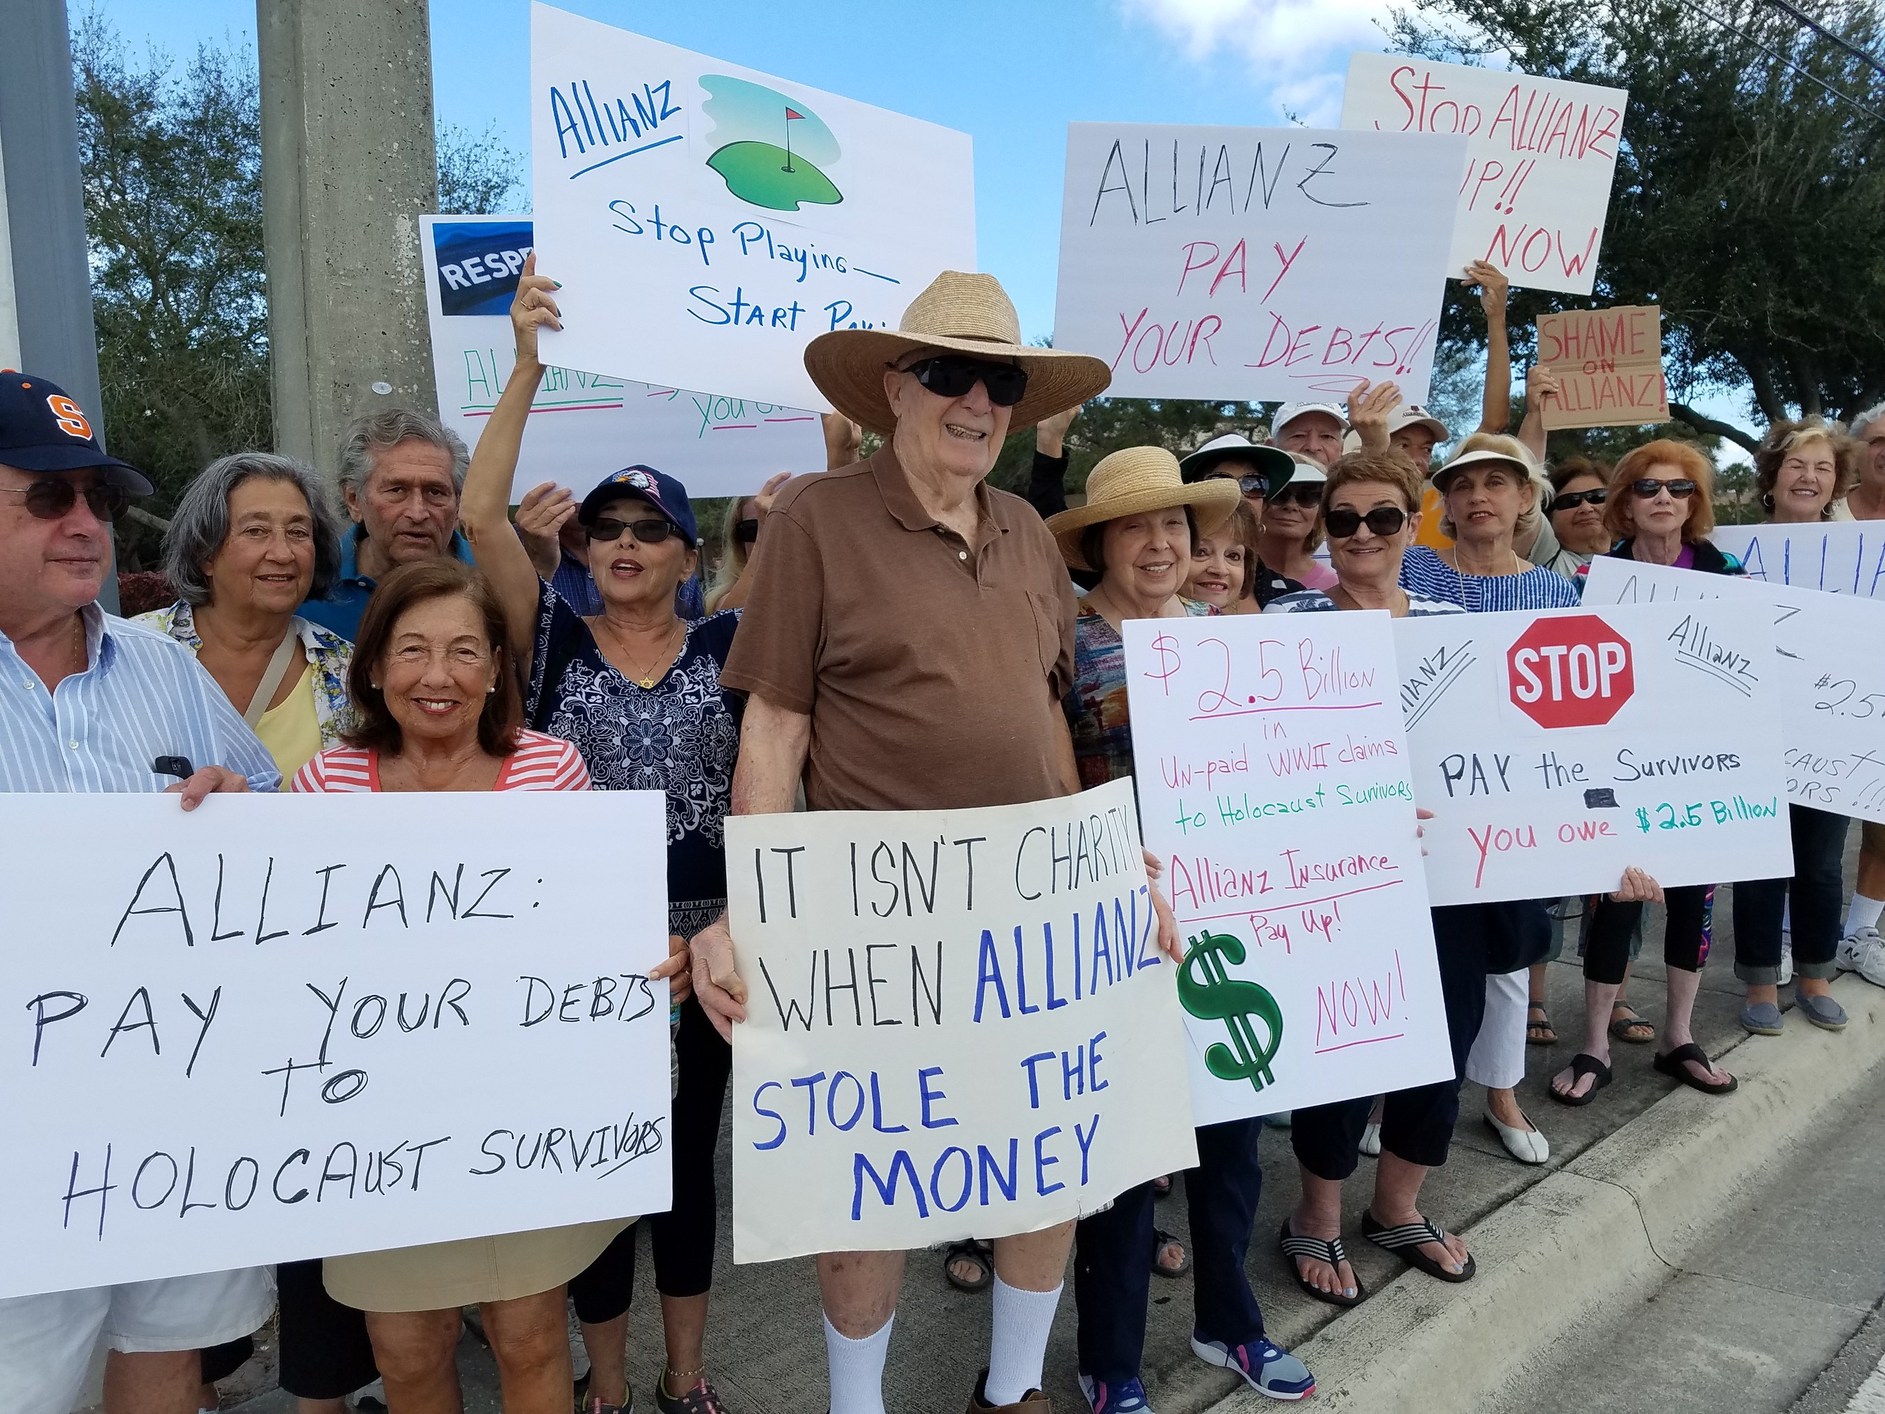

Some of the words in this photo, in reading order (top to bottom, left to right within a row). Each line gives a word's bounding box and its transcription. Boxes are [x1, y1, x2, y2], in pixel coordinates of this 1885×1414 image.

[1489, 84, 1620, 160] ALLIANZ
[1090, 137, 1371, 227] ALLIANZ
[608, 199, 715, 266] Stop
[1484, 224, 1598, 278] NOW
[440, 246, 534, 291] RESP
[1177, 235, 1308, 305] PAY
[1111, 307, 1222, 373] YOUR
[1543, 313, 1646, 362] SHAME
[1583, 358, 1615, 375] ON
[47, 394, 93, 441] S
[1514, 641, 1626, 703] STOP
[1263, 717, 1287, 740] in
[1338, 734, 1398, 764] claims
[1438, 753, 1510, 797] PAY
[1534, 751, 1590, 790] the
[1175, 798, 1206, 835] to
[1216, 783, 1325, 827] Holocaust
[1558, 821, 1618, 844] owe
[754, 845, 805, 923] IT
[850, 834, 987, 917] ISN'T
[1015, 804, 1137, 900] CHARITY
[758, 941, 943, 1031] WHEN
[973, 884, 1161, 1023] ALLIANZ
[1250, 914, 1291, 954] Pay
[26, 986, 221, 1078] PAY
[306, 977, 471, 1066] YOUR
[516, 974, 655, 1027] DEBTS
[1316, 949, 1409, 1047] NOW!
[261, 1058, 368, 1118] TO
[752, 1066, 959, 1151] STOLE
[1020, 1030, 1109, 1109] THE
[62, 1136, 452, 1242] HOLOCAUST
[469, 1111, 666, 1176] SURVIVORS
[851, 1113, 1100, 1221] MONEY
